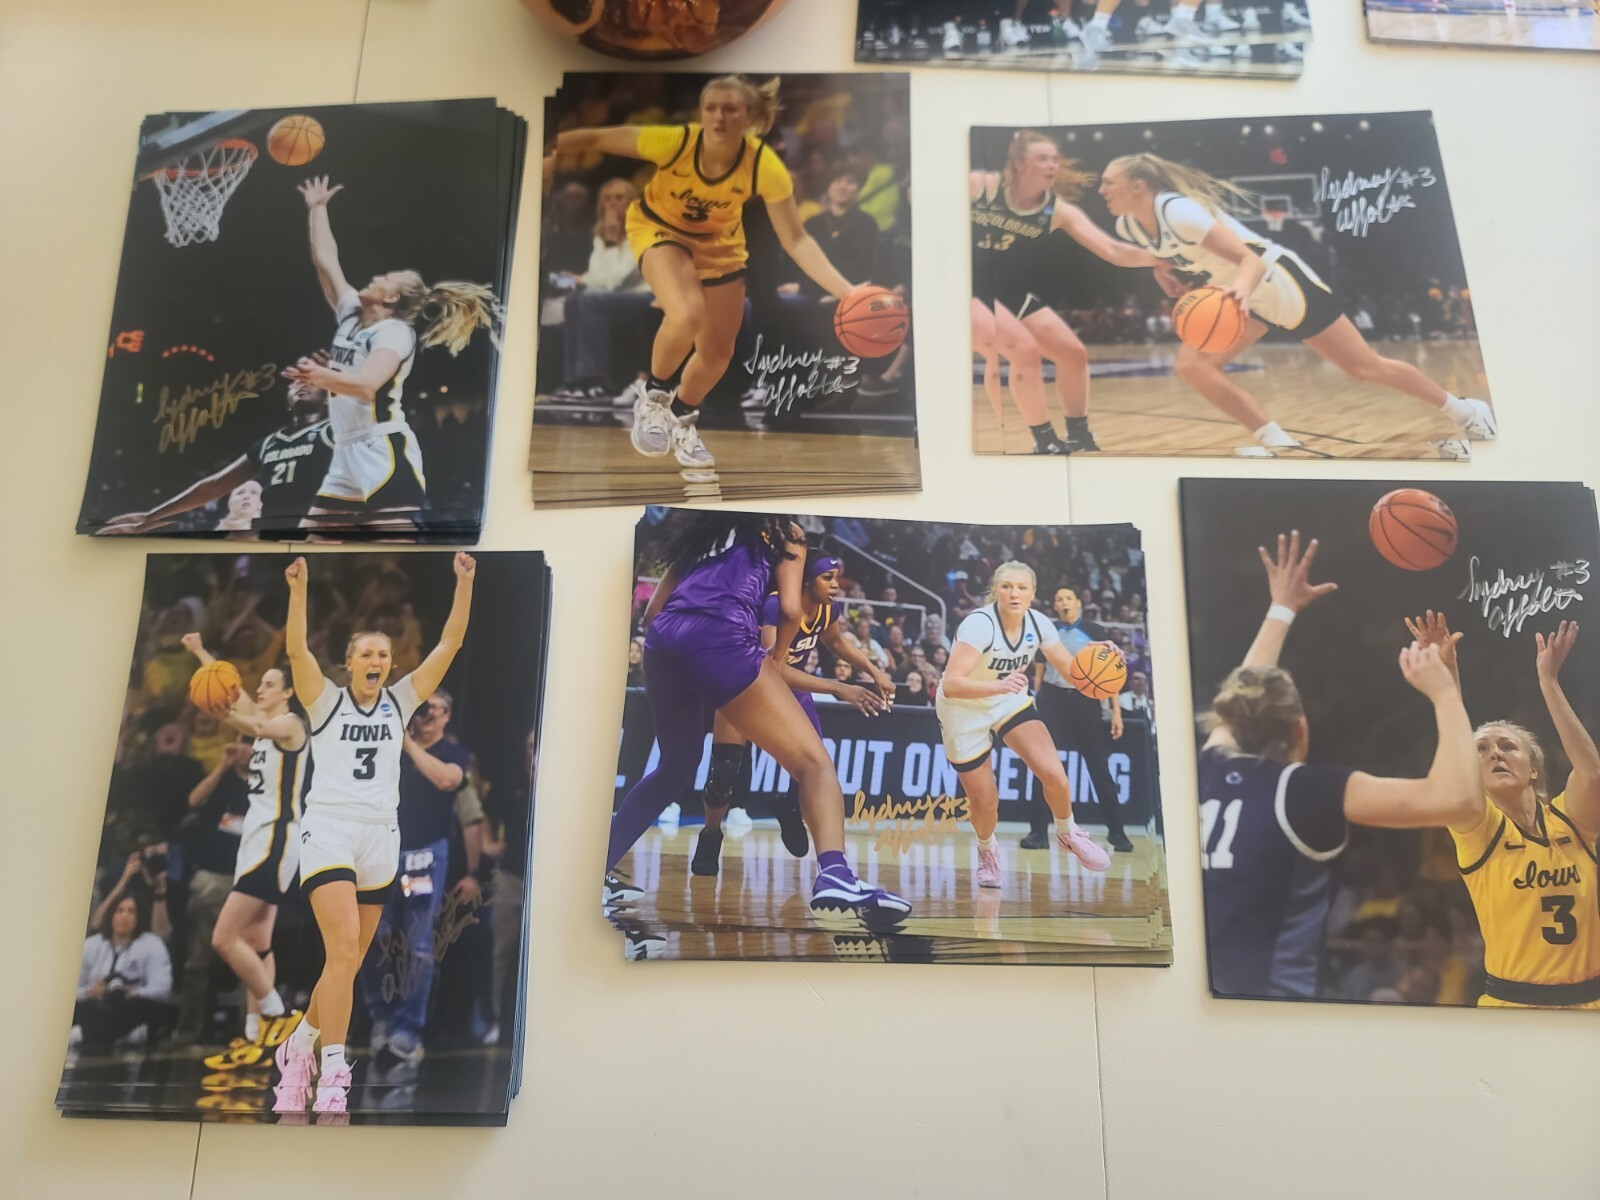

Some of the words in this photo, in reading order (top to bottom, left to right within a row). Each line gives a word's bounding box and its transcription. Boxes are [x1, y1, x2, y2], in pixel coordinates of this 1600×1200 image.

[1396, 166, 1437, 190] #3
[824, 355, 860, 375] #3
[263, 443, 315, 465] COLORADO
[270, 460, 297, 485] 21
[1549, 559, 1590, 585] #3
[988, 653, 1029, 672] IOWA
[340, 723, 393, 742] IOWA
[353, 747, 379, 780] 3
[939, 796, 972, 822] #3
[1200, 797, 1244, 870] 11
[1513, 860, 1582, 890] Iowa
[1541, 894, 1578, 946] 3
